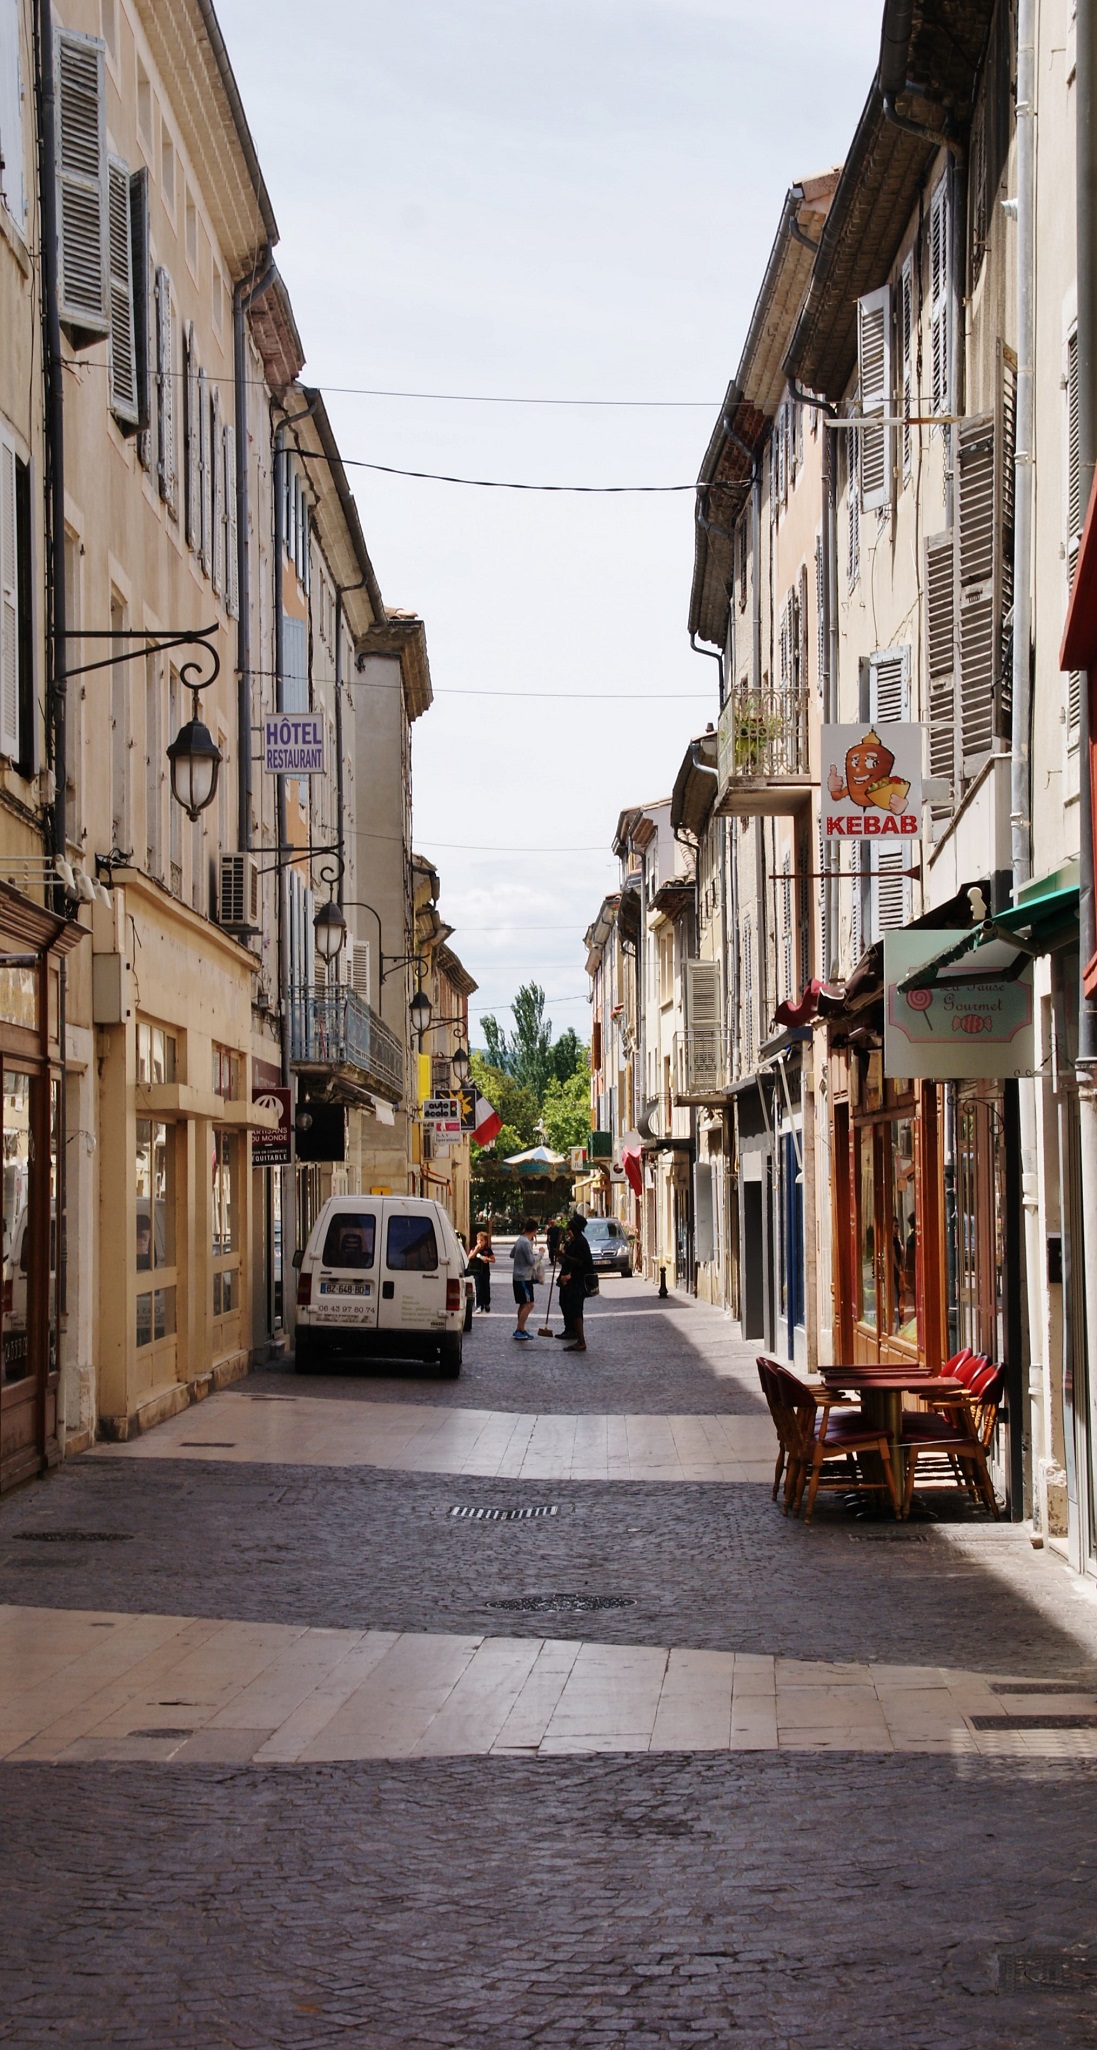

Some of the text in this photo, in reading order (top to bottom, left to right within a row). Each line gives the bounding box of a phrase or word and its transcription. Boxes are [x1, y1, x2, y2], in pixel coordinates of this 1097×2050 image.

[266, 717, 322, 745] HÔTEL
[267, 749, 322, 768] RESTAURANT
[827, 815, 918, 835] KEBAB
[943, 993, 1002, 1011] Gourmet
[429, 1101, 449, 1109] auto
